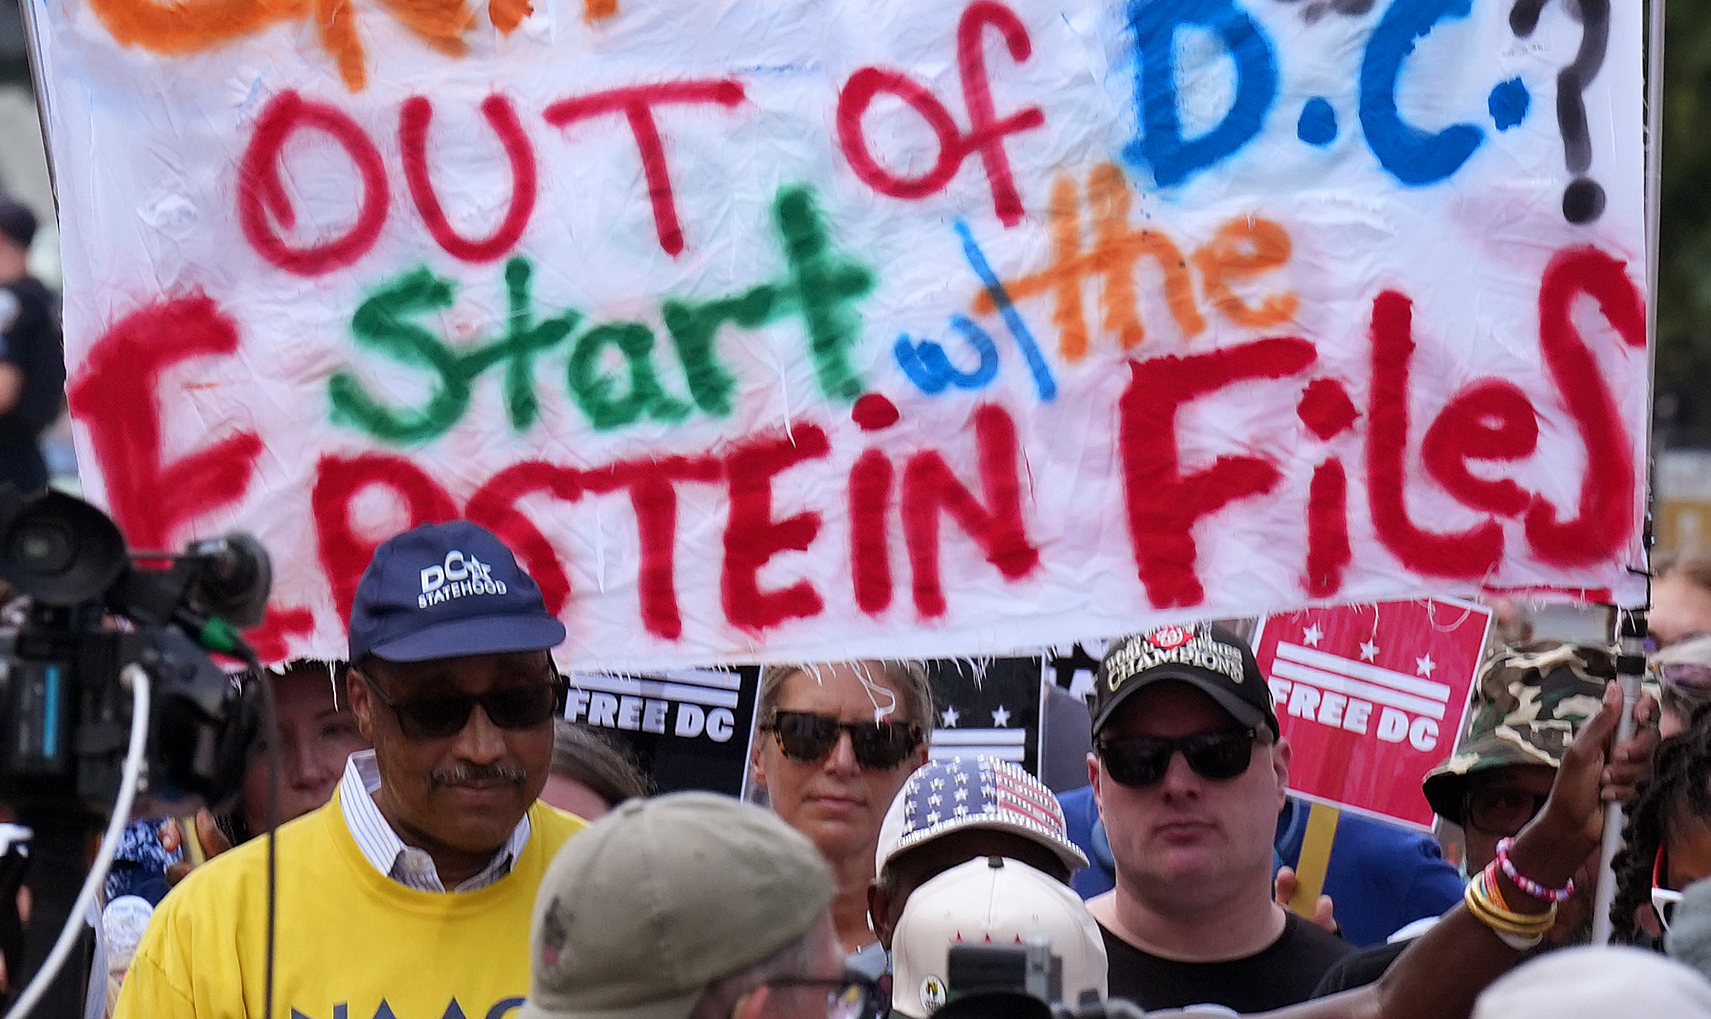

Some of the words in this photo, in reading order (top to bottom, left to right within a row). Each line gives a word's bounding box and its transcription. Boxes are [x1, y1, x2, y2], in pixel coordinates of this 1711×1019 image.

[239, 79, 746, 276] OUT
[330, 187, 874, 443] Start
[418, 579, 507, 609] STATEHOOD
[1108, 647, 1244, 692] CHAMPIONS
[563, 687, 669, 735] FREE
[675, 701, 735, 743] DC
[1268, 675, 1373, 735] FREE
[1376, 705, 1439, 752] DC
